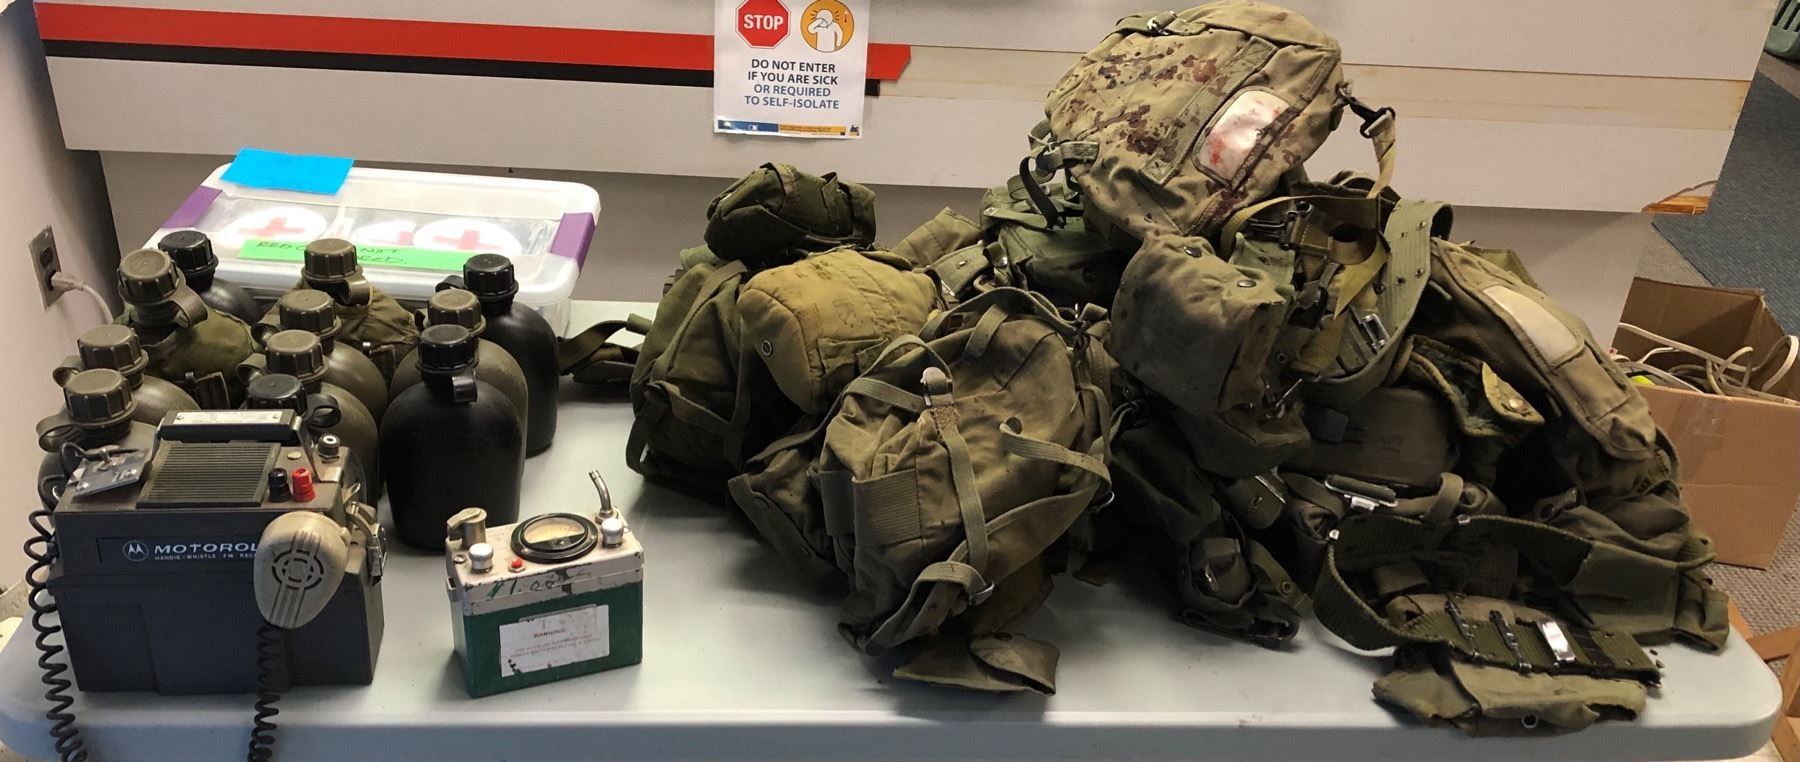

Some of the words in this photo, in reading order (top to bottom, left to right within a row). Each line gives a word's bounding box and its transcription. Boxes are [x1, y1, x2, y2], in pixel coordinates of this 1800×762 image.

[743, 14, 784, 31] STOP
[751, 59, 769, 69] DO
[772, 60, 796, 71] NOT
[799, 62, 836, 73] ENTER
[748, 71, 757, 81] IF
[760, 72, 785, 83] YOU
[787, 73, 809, 84] ARE
[813, 75, 838, 85] SICK
[754, 84, 770, 94] OR
[773, 85, 831, 97] REQUIRED
[744, 95, 760, 106] TO
[762, 96, 840, 110] SELF-ISOLATE
[256, 241, 293, 249] RED
[154, 543, 258, 554] MOTOROL
[533, 628, 566, 639] WARNING
